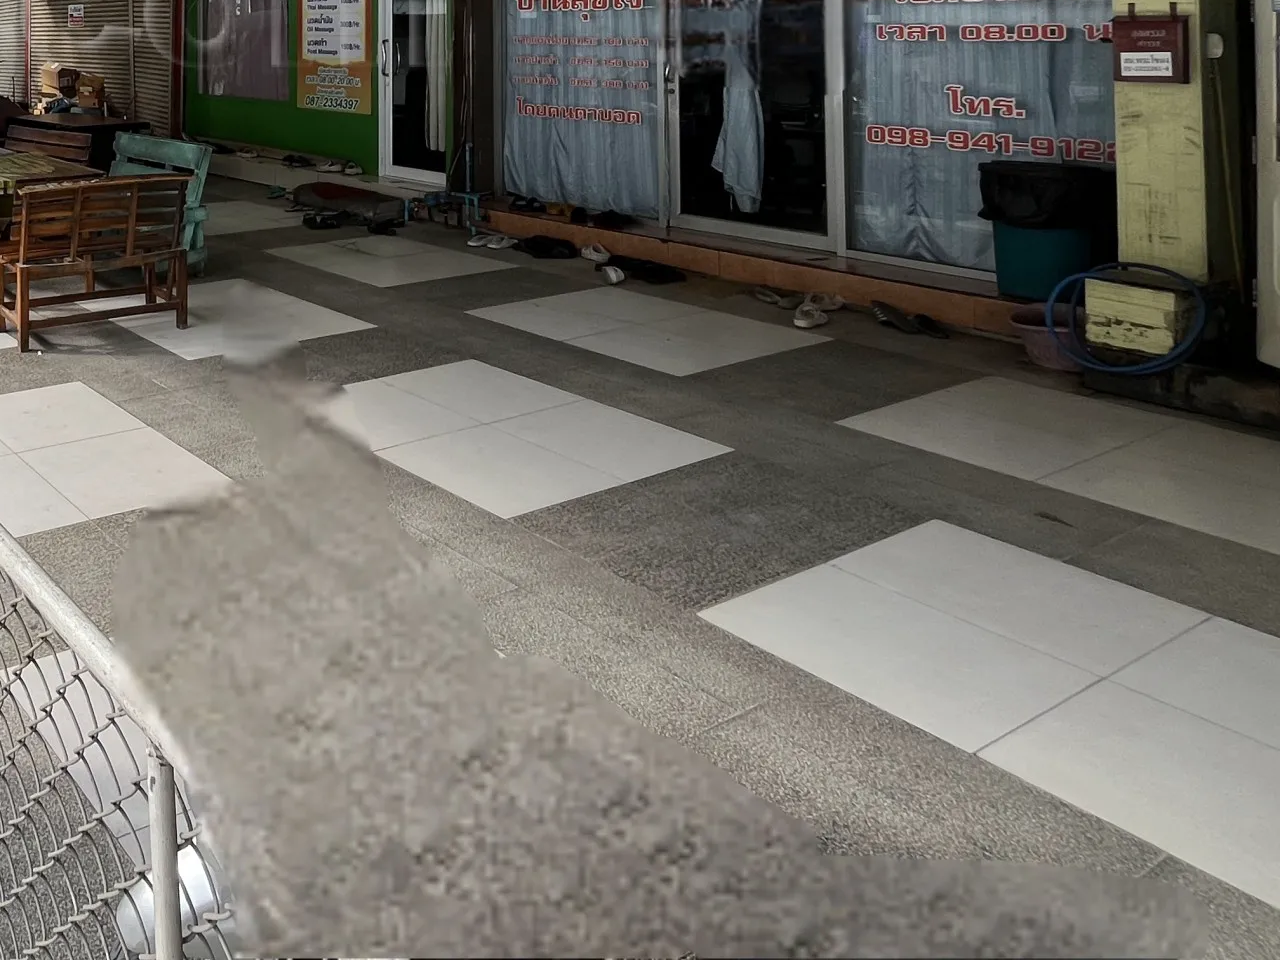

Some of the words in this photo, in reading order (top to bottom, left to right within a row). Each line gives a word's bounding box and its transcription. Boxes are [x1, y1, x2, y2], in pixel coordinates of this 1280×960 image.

[876, 23, 947, 41] เวลา
[959, 22, 1067, 42] 08.00
[516, 95, 642, 125] โดยคนตาบอด
[944, 83, 1026, 119] โทร.
